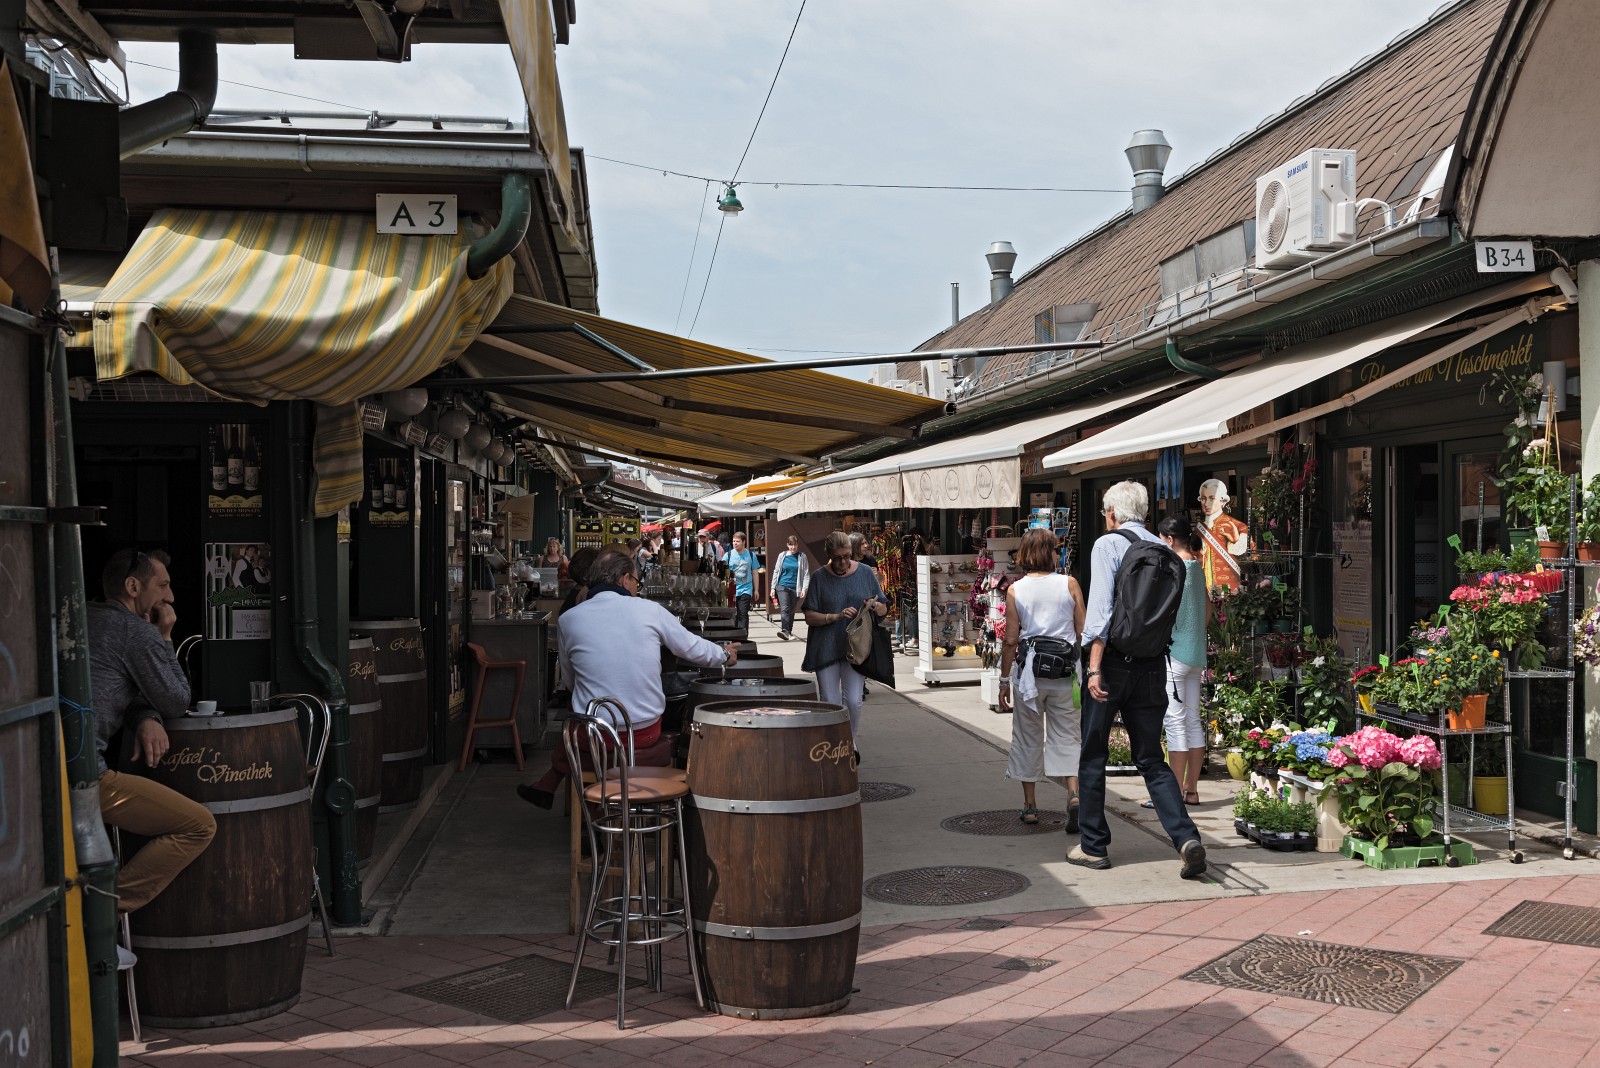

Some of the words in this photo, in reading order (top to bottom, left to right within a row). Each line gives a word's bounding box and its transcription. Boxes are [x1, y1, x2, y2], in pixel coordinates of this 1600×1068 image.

[1287, 160, 1308, 178] SAMSUNG
[389, 200, 417, 227] A
[428, 200, 447, 228] 3
[1485, 246, 1498, 267] B
[1500, 248, 1526, 267] 3-4
[196, 760, 273, 784] Vinothek
